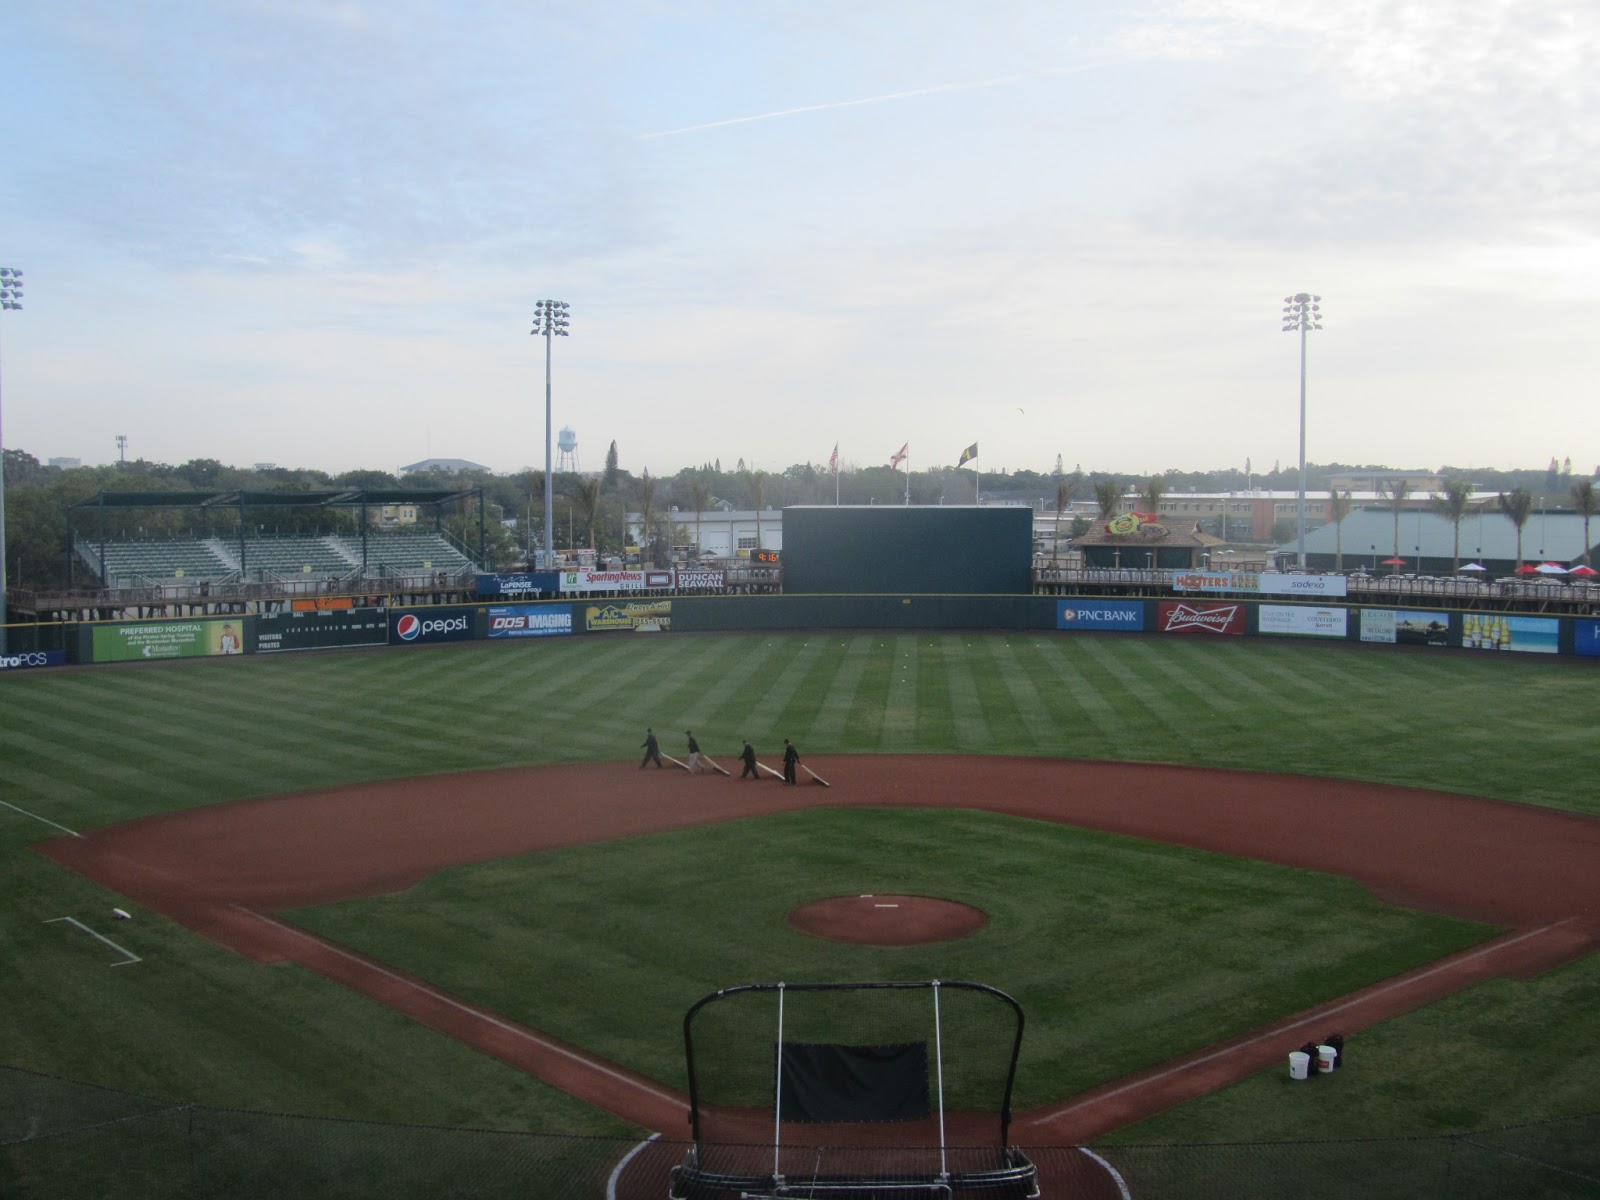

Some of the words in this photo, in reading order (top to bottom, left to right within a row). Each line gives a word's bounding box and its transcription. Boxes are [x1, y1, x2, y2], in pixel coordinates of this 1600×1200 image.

[678, 580, 724, 588] SEAWALL
[1176, 576, 1228, 588] HOOTERS
[602, 610, 619, 618] A/C
[1166, 610, 1233, 623] Budweiser
[422, 616, 466, 635] pepsi
[492, 616, 526, 629] DOS
[528, 614, 572, 629] IMAGING
[120, 626, 164, 635] PREFERRED
[166, 624, 202, 633] HOSPITAL
